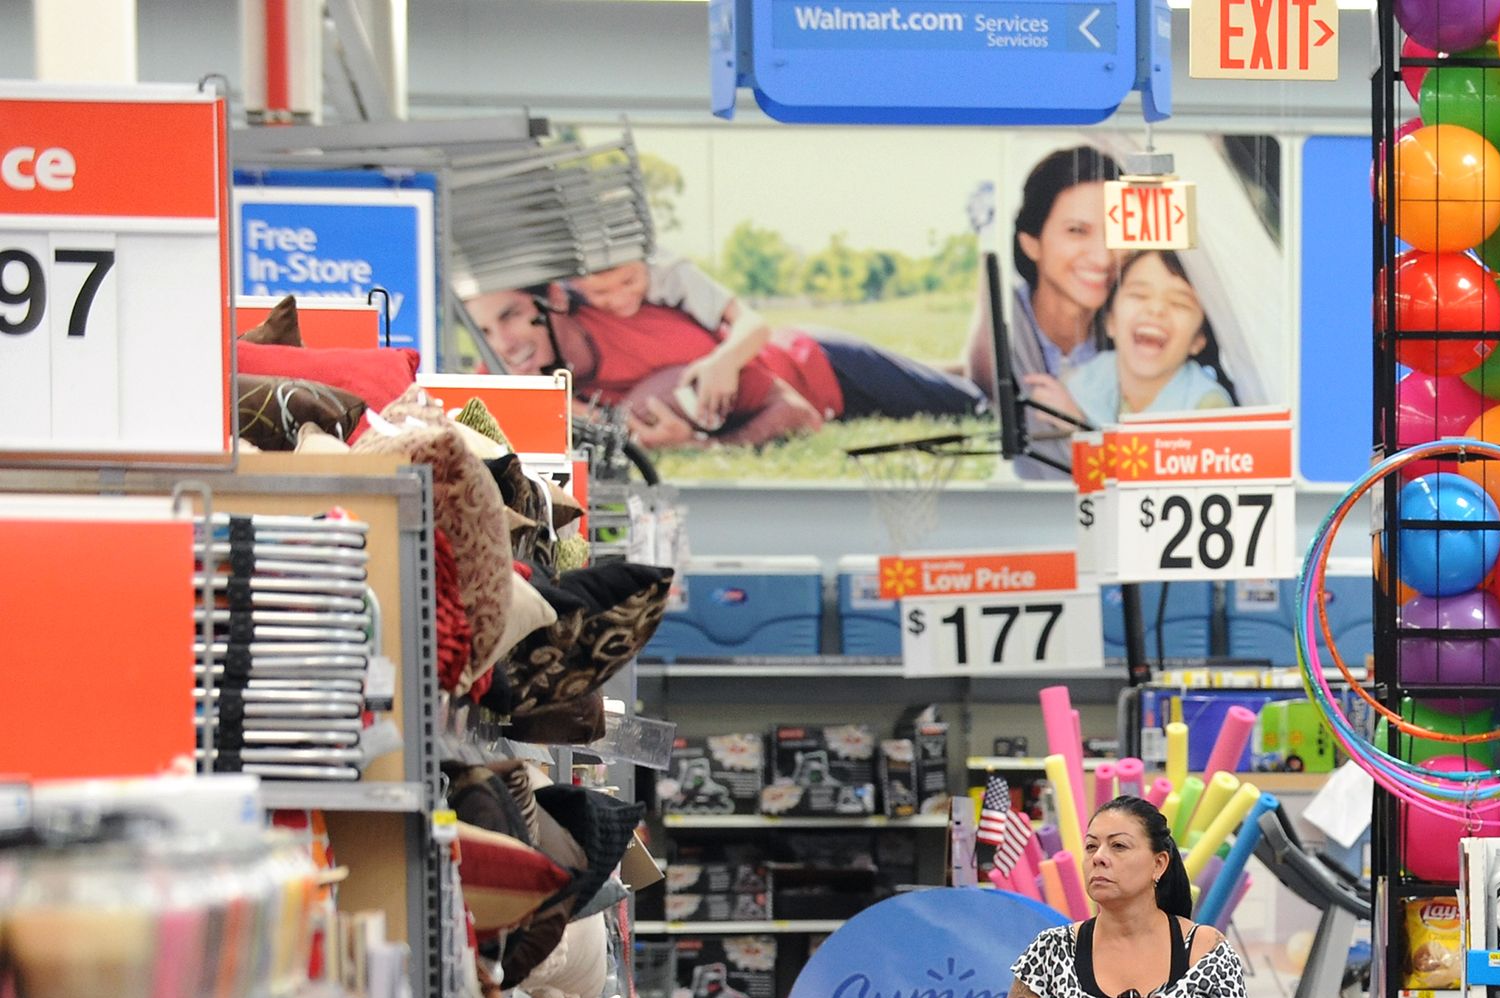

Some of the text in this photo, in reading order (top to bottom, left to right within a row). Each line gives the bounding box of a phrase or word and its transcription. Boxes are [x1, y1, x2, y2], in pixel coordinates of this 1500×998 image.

[794, 6, 1049, 33] Walmart.com Services
[987, 33, 1049, 47] Servicios
[1220, 0, 1317, 70] EXIT
[1121, 188, 1174, 242] EXIT
[247, 220, 318, 252] Free
[248, 252, 373, 283] In-Store
[0, 249, 116, 337] 97
[1154, 438, 1192, 450] Everyday
[1154, 448, 1254, 474] Low Price
[922, 566, 1036, 591] Low Price
